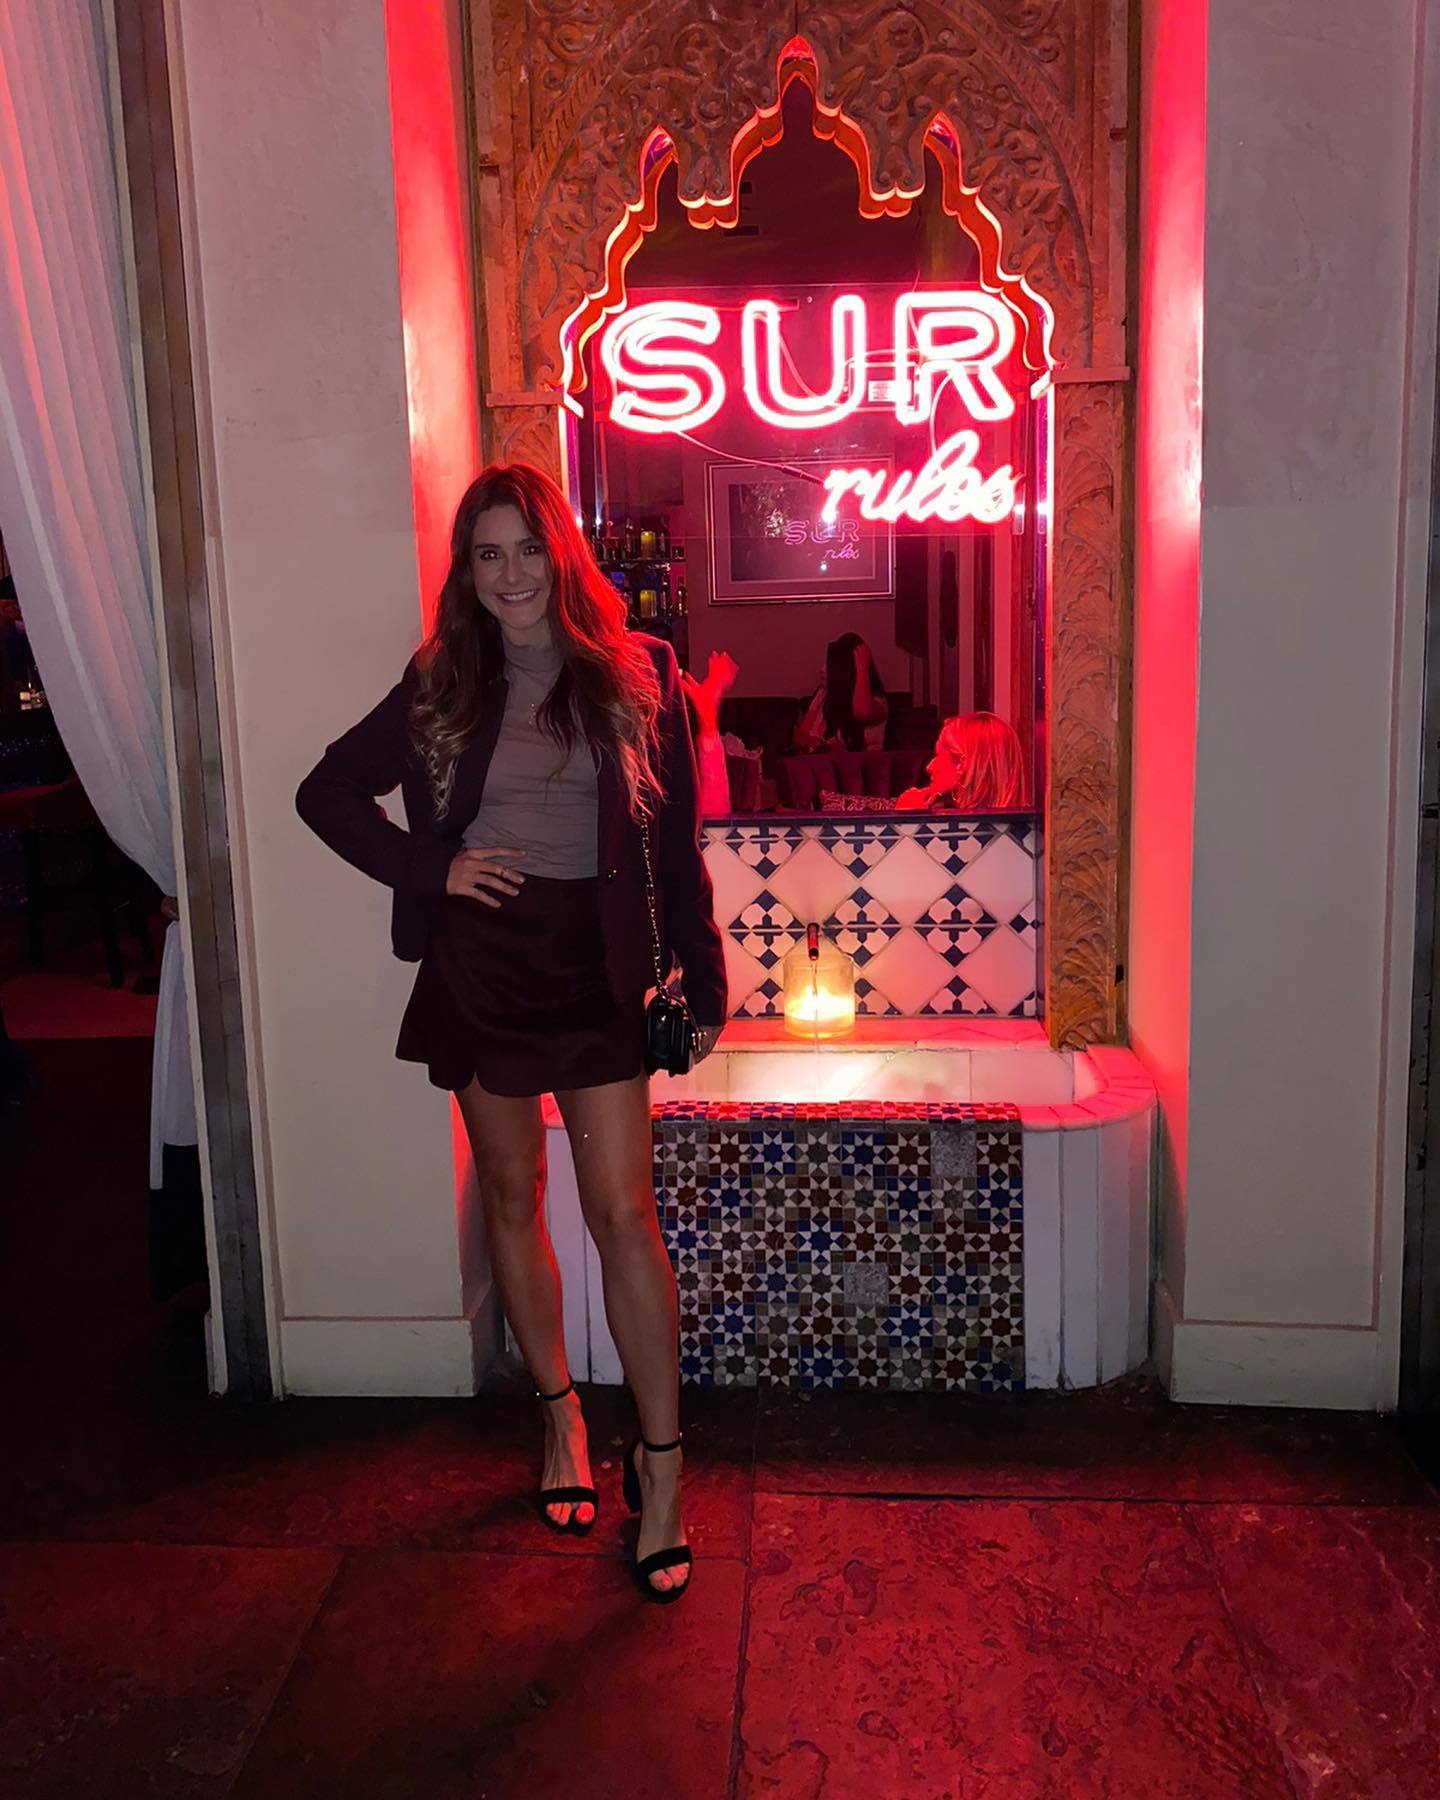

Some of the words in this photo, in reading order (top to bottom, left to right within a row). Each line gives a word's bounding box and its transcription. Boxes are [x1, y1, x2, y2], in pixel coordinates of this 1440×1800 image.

[600, 290, 1017, 434] SUR
[821, 430, 1015, 524] rules
[784, 519, 860, 545] SUR
